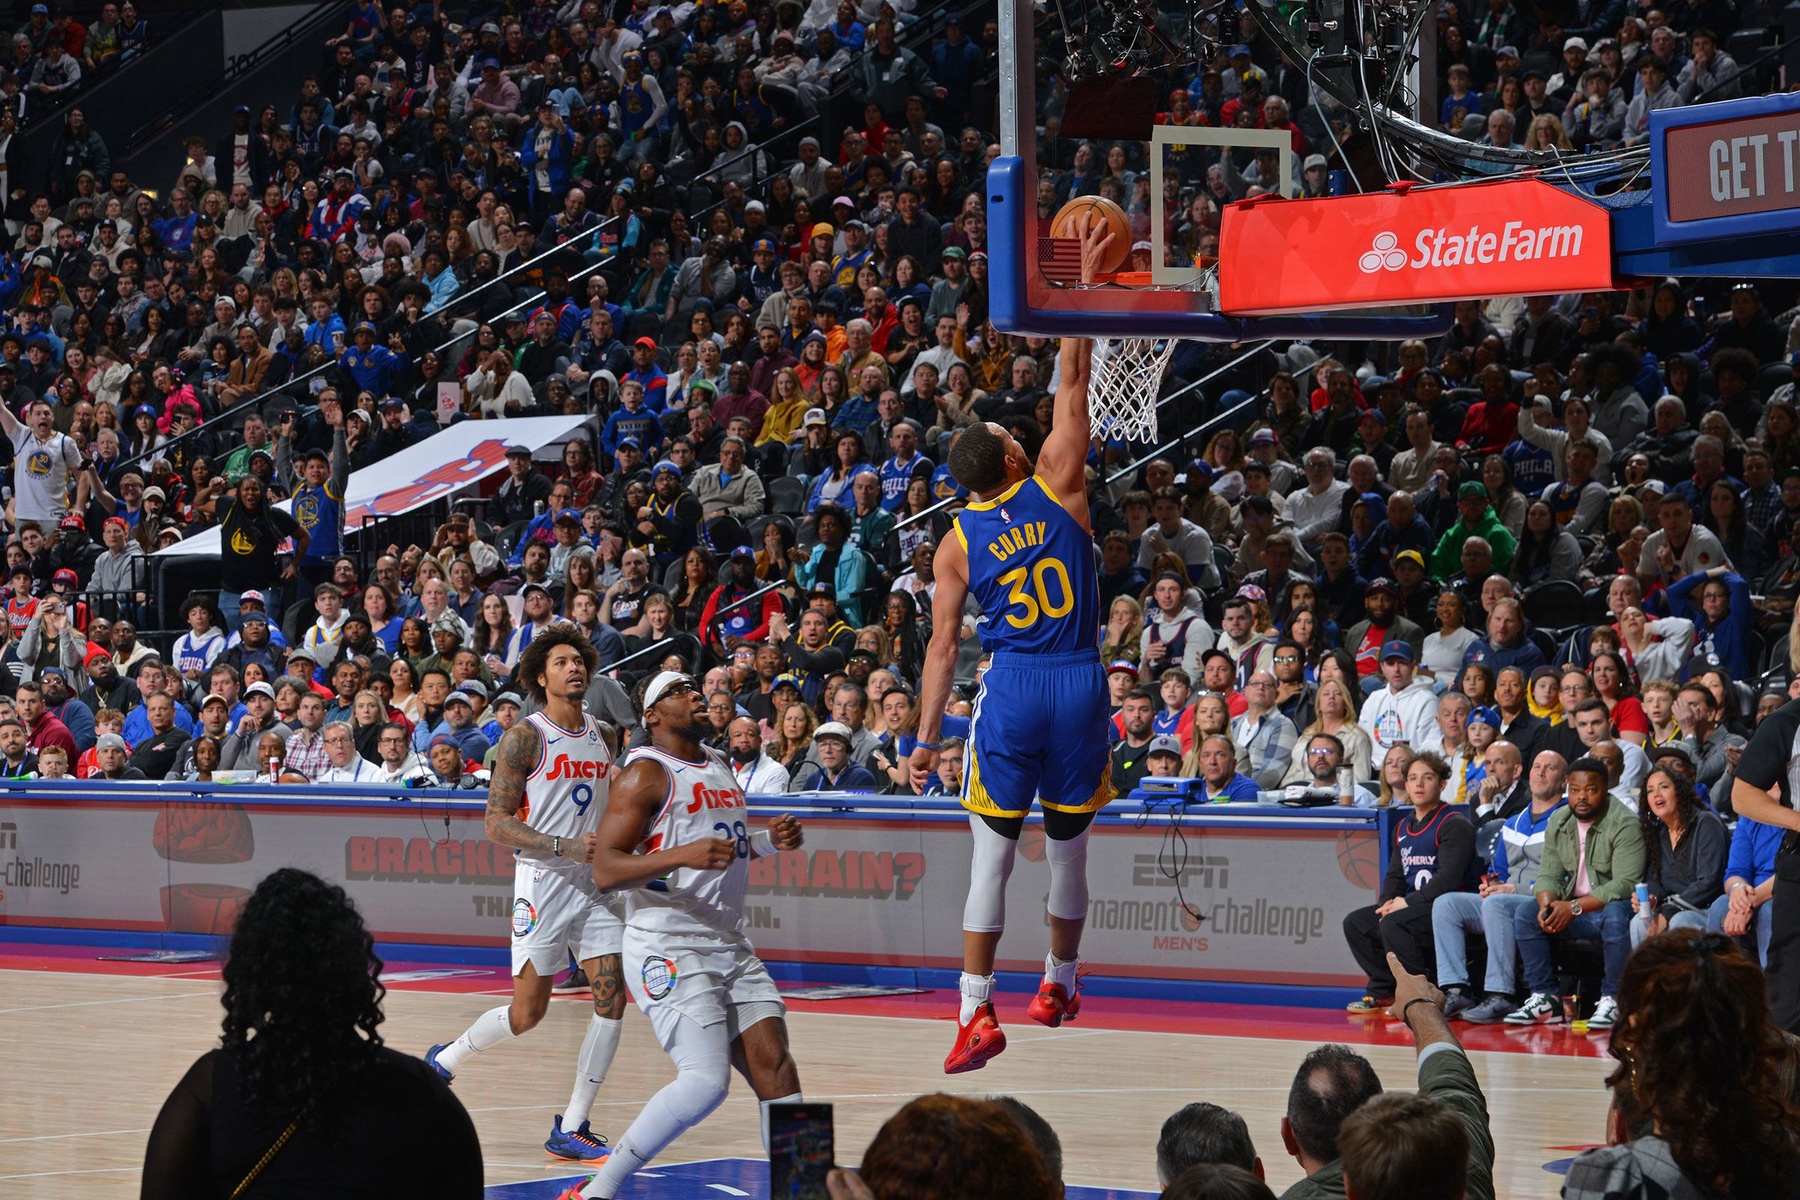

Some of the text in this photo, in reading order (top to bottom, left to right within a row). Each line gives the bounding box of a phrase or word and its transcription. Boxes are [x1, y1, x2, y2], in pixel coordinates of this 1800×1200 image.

[1709, 130, 1800, 201] GET T
[25, 469, 53, 481] WARRIORS
[39, 454, 49, 464] 30
[1514, 459, 1553, 477] PHILA
[305, 501, 313, 509] 30
[988, 521, 1046, 562] CURRY
[996, 557, 1074, 629] 30
[180, 656, 205, 671] PHILA
[546, 754, 610, 781] Sixers
[571, 784, 593, 816] 9
[347, 836, 516, 882] BRACKE
[748, 850, 926, 899] BRAIN?
[1132, 854, 1230, 889] ESPN
[5, 856, 80, 895] challenge
[472, 896, 514, 917] TH
[1211, 897, 1324, 944] challenge
[1153, 935, 1209, 951] MEN'S
